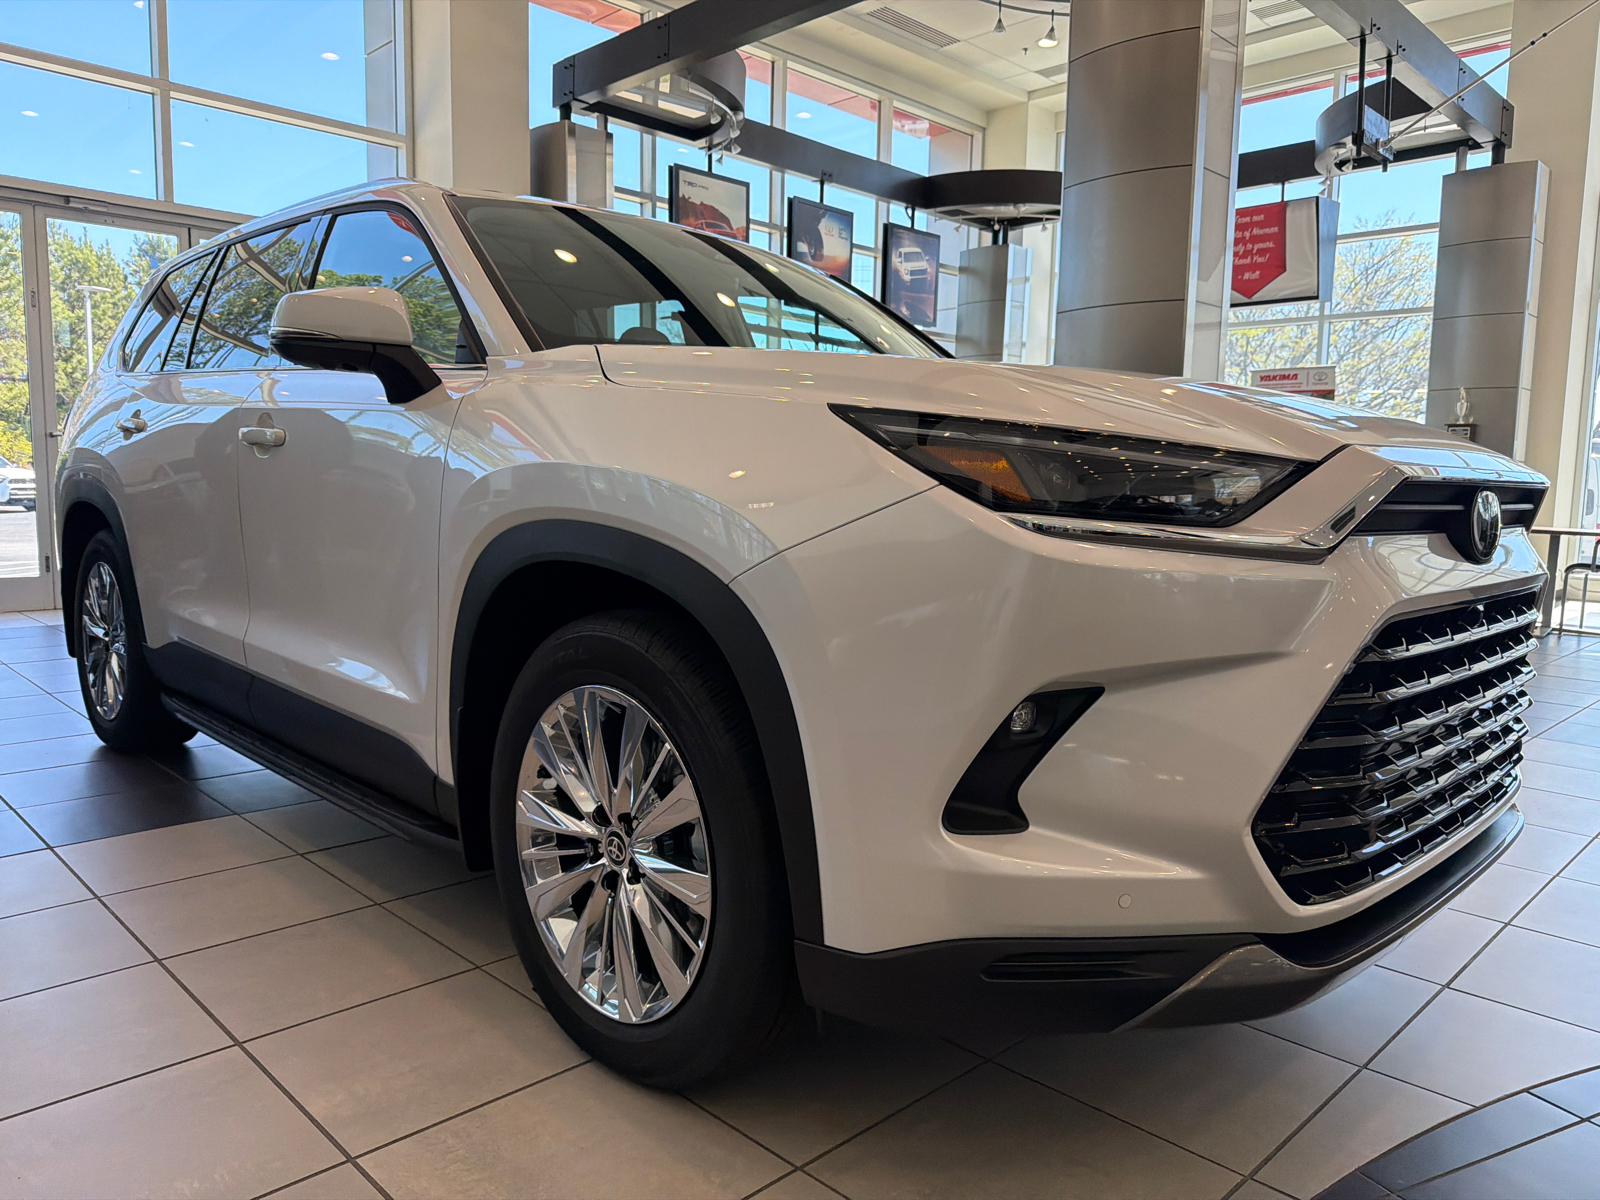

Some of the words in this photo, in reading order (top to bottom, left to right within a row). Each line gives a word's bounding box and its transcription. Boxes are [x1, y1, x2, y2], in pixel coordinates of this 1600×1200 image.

[1243, 227, 1251, 240] of
[1246, 243, 1253, 251] to
[1233, 254, 1251, 265] hank
[1259, 373, 1299, 382] YAKIMA
